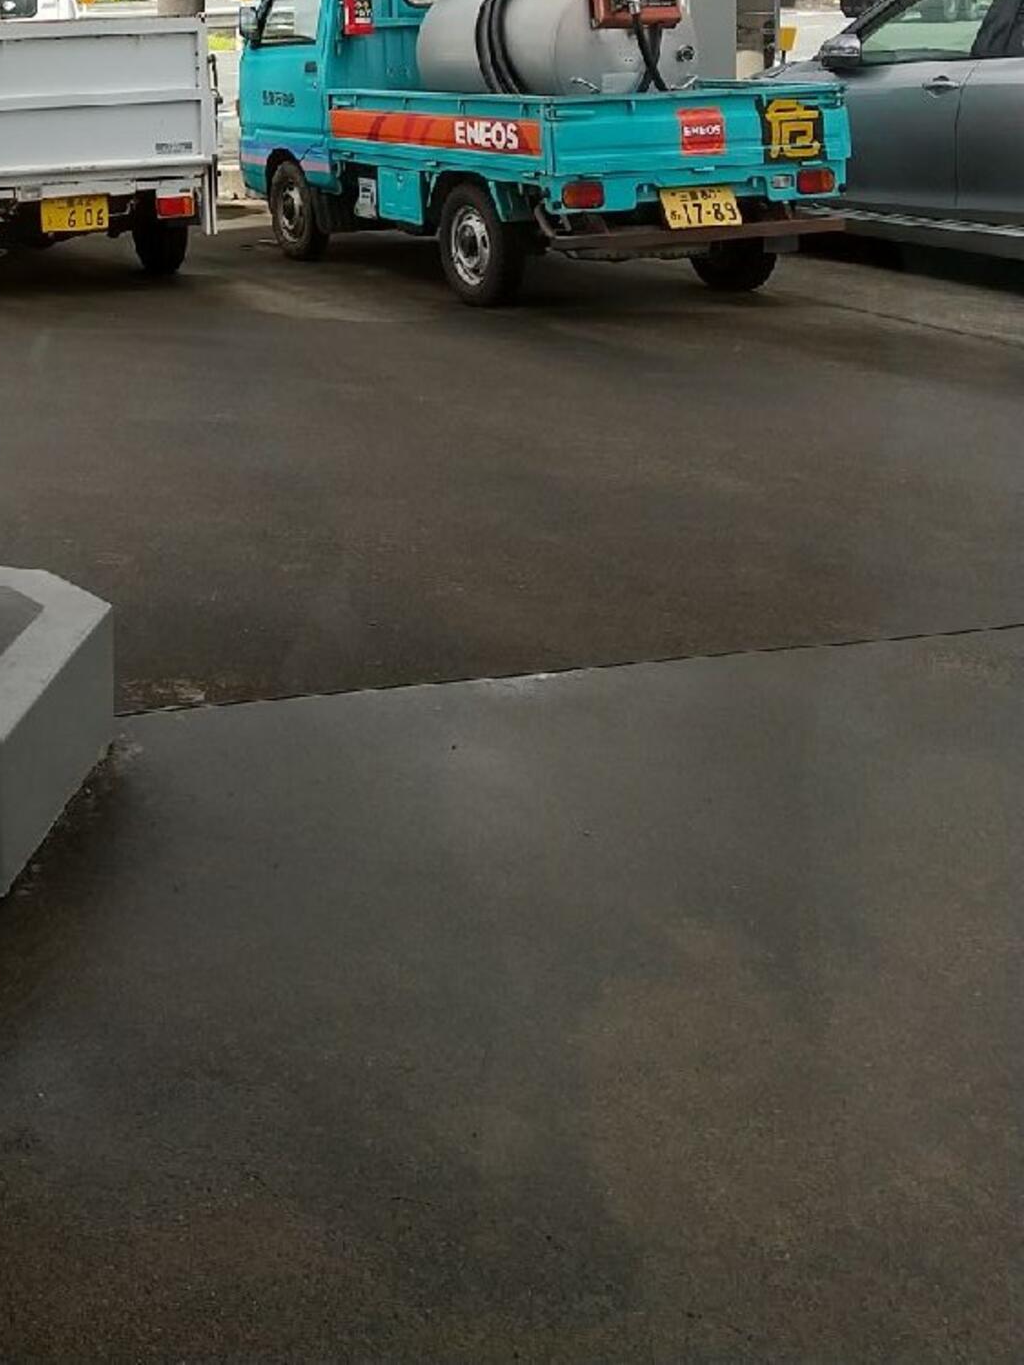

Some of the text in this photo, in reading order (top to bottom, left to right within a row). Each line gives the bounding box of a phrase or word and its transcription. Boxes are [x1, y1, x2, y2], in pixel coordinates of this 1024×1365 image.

[454, 120, 519, 150] ENEOS
[683, 124, 721, 137] ENEOS
[764, 98, 821, 159] 危
[682, 202, 738, 225] 17-89
